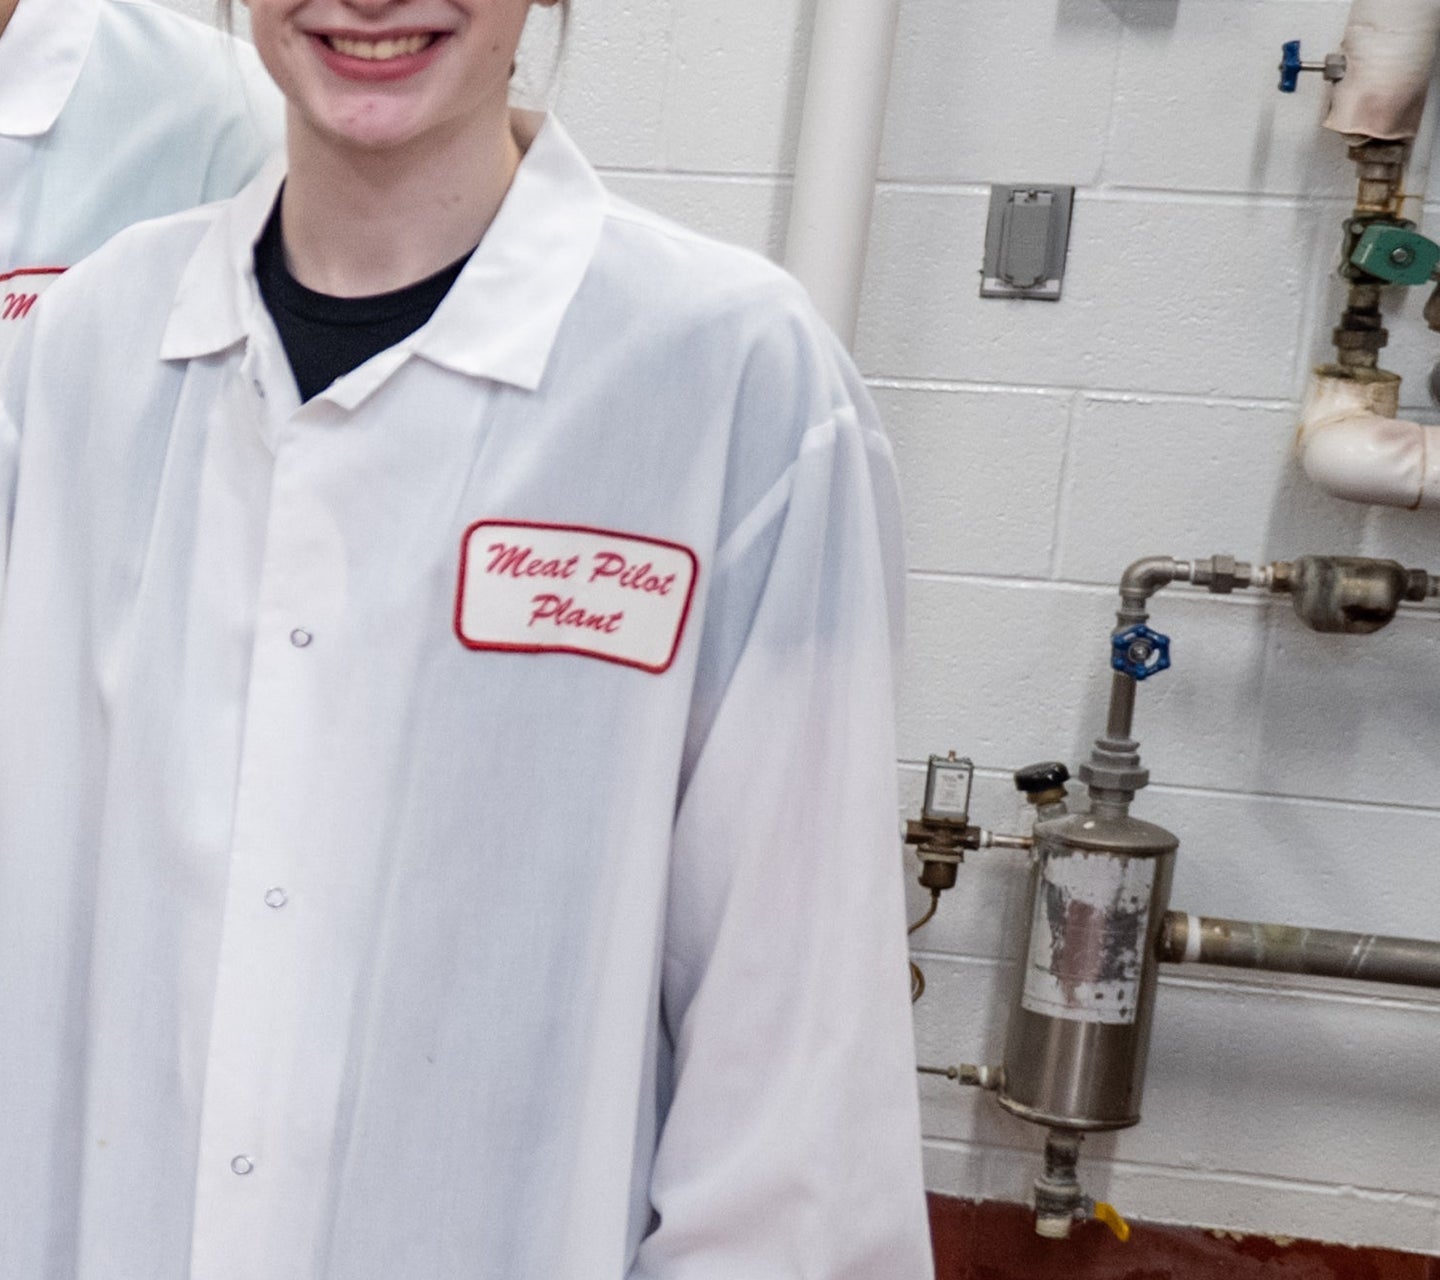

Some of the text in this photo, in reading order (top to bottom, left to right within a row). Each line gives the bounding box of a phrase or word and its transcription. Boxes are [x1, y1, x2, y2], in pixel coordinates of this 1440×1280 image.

[486, 543, 676, 597] Meat Pilot
[528, 594, 623, 634] Plant
